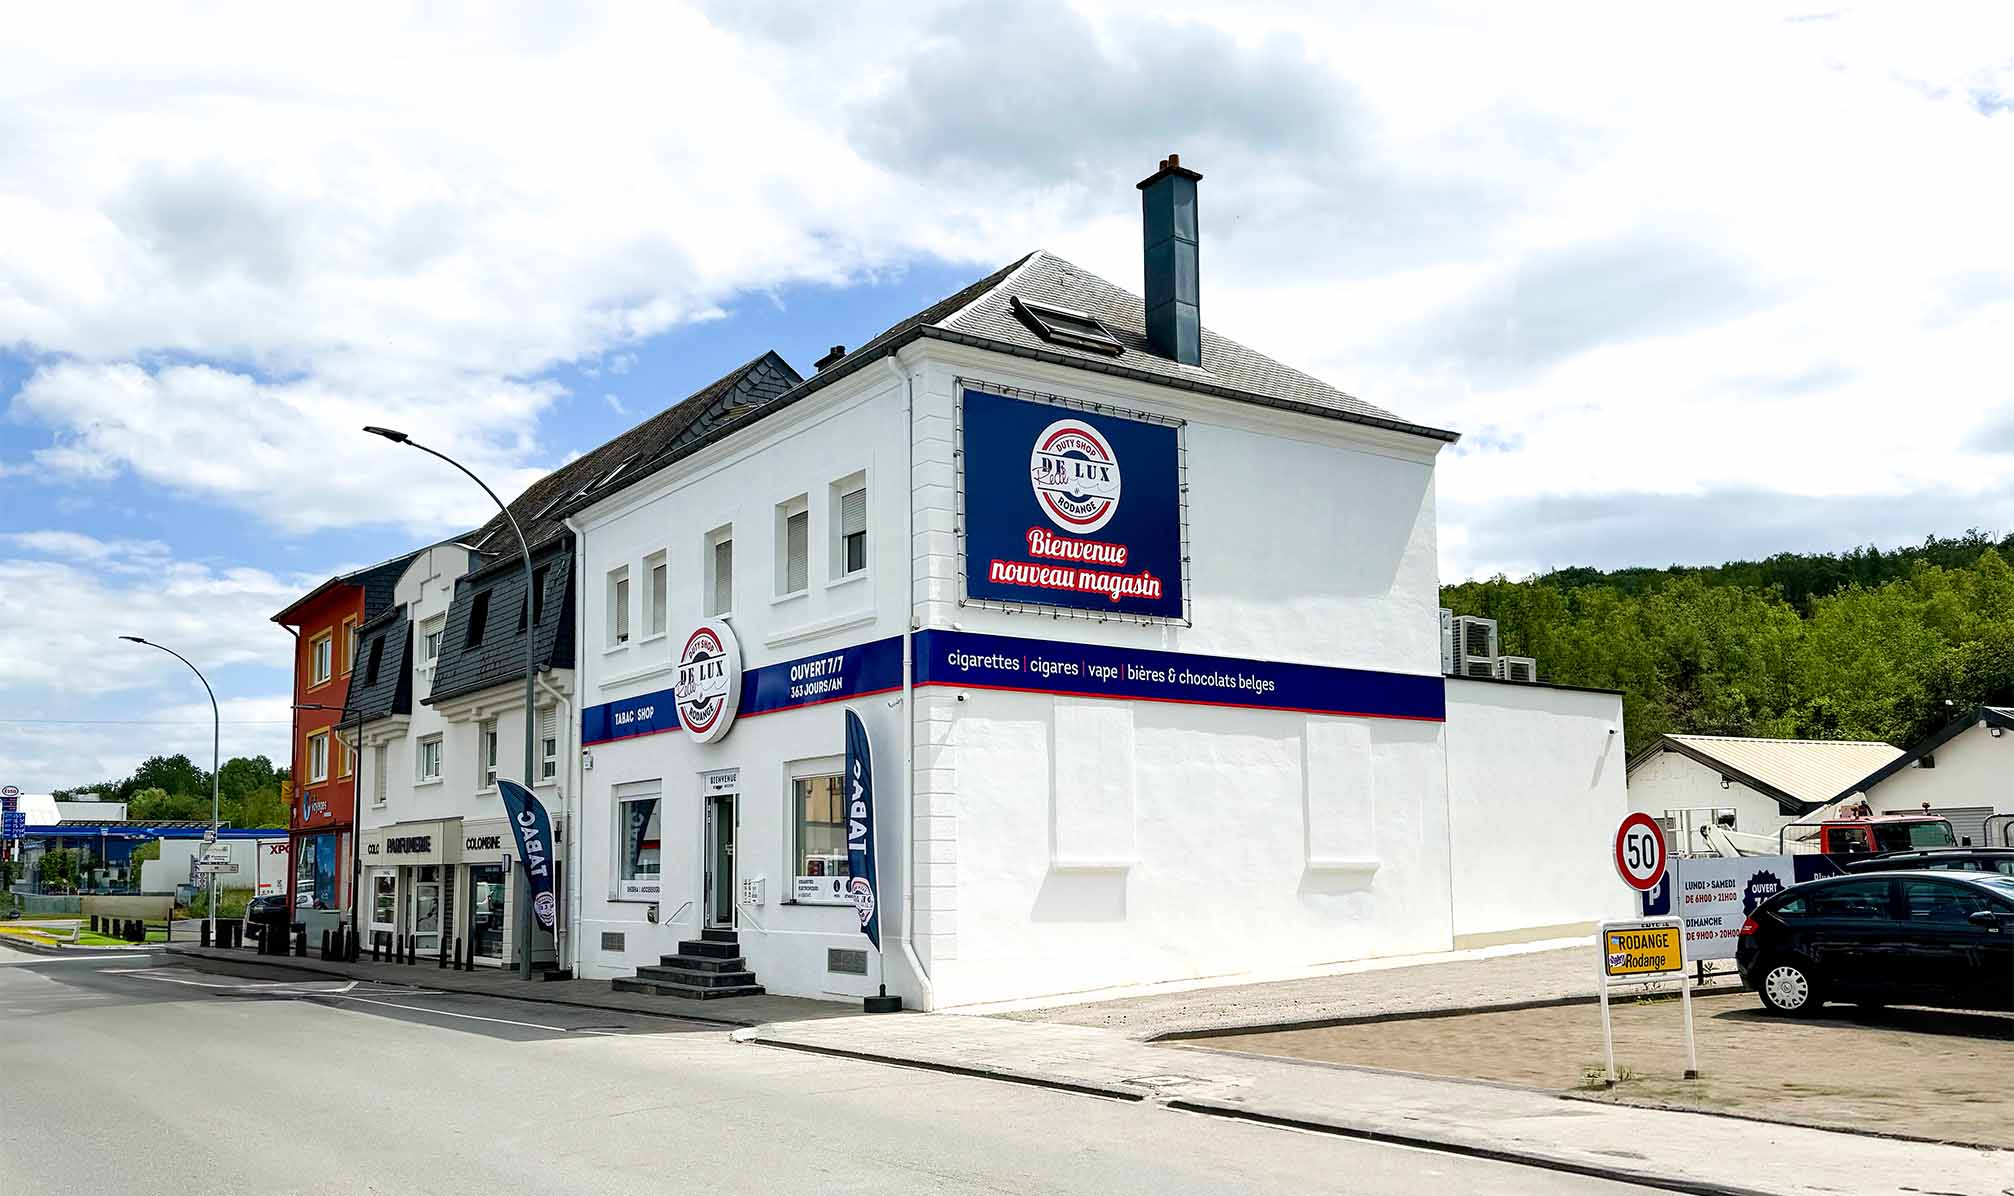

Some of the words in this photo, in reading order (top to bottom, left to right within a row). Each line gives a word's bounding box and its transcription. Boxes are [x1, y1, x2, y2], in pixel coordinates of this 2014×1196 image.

[1056, 439, 1075, 452] DUTY
[1076, 440, 1097, 457] SHOP
[1042, 457, 1065, 475] DE
[1075, 463, 1110, 482] LUX
[1057, 496, 1097, 515] RODANGE
[1029, 529, 1126, 564] Bienvenue
[991, 562, 1075, 588] nouveau
[1078, 572, 1161, 600] magasin
[689, 641, 701, 659] DUTY
[701, 640, 715, 653] SHOP
[700, 660, 724, 681] LUX
[791, 659, 827, 682] OUVERT
[828, 656, 844, 674] 7/7
[948, 649, 1020, 671] cigarettes
[1030, 656, 1079, 678] cigares
[1088, 664, 1118, 683] vape
[1127, 663, 1165, 682] bières
[1179, 668, 1237, 689] chocolats
[1238, 673, 1275, 694] belges
[791, 684, 804, 698] 363
[804, 677, 843, 696] JOURS/AN
[615, 711, 635, 725] TABAC
[637, 705, 655, 722] SHOP
[689, 702, 715, 722] RODANGE
[710, 773, 737, 785] BIENVENUE
[386, 835, 432, 853] PARFUMERIE
[465, 836, 501, 850] COLOMBINE
[1627, 834, 1655, 870] 50
[1685, 881, 1706, 891] LUNDI
[1711, 880, 1736, 889] SAMEDI
[1752, 883, 1778, 894] OUVERT
[1685, 894, 1694, 904] DE
[1695, 893, 1712, 903] 6H00
[1718, 891, 1738, 901] 21H00
[1686, 916, 1722, 928] DIMANCHE
[1618, 933, 1670, 950] RODANGE
[1687, 931, 1695, 941] DE
[1696, 930, 1714, 940] 9H00
[1720, 928, 1740, 939] 20H00
[1626, 953, 1666, 970] Rodange
